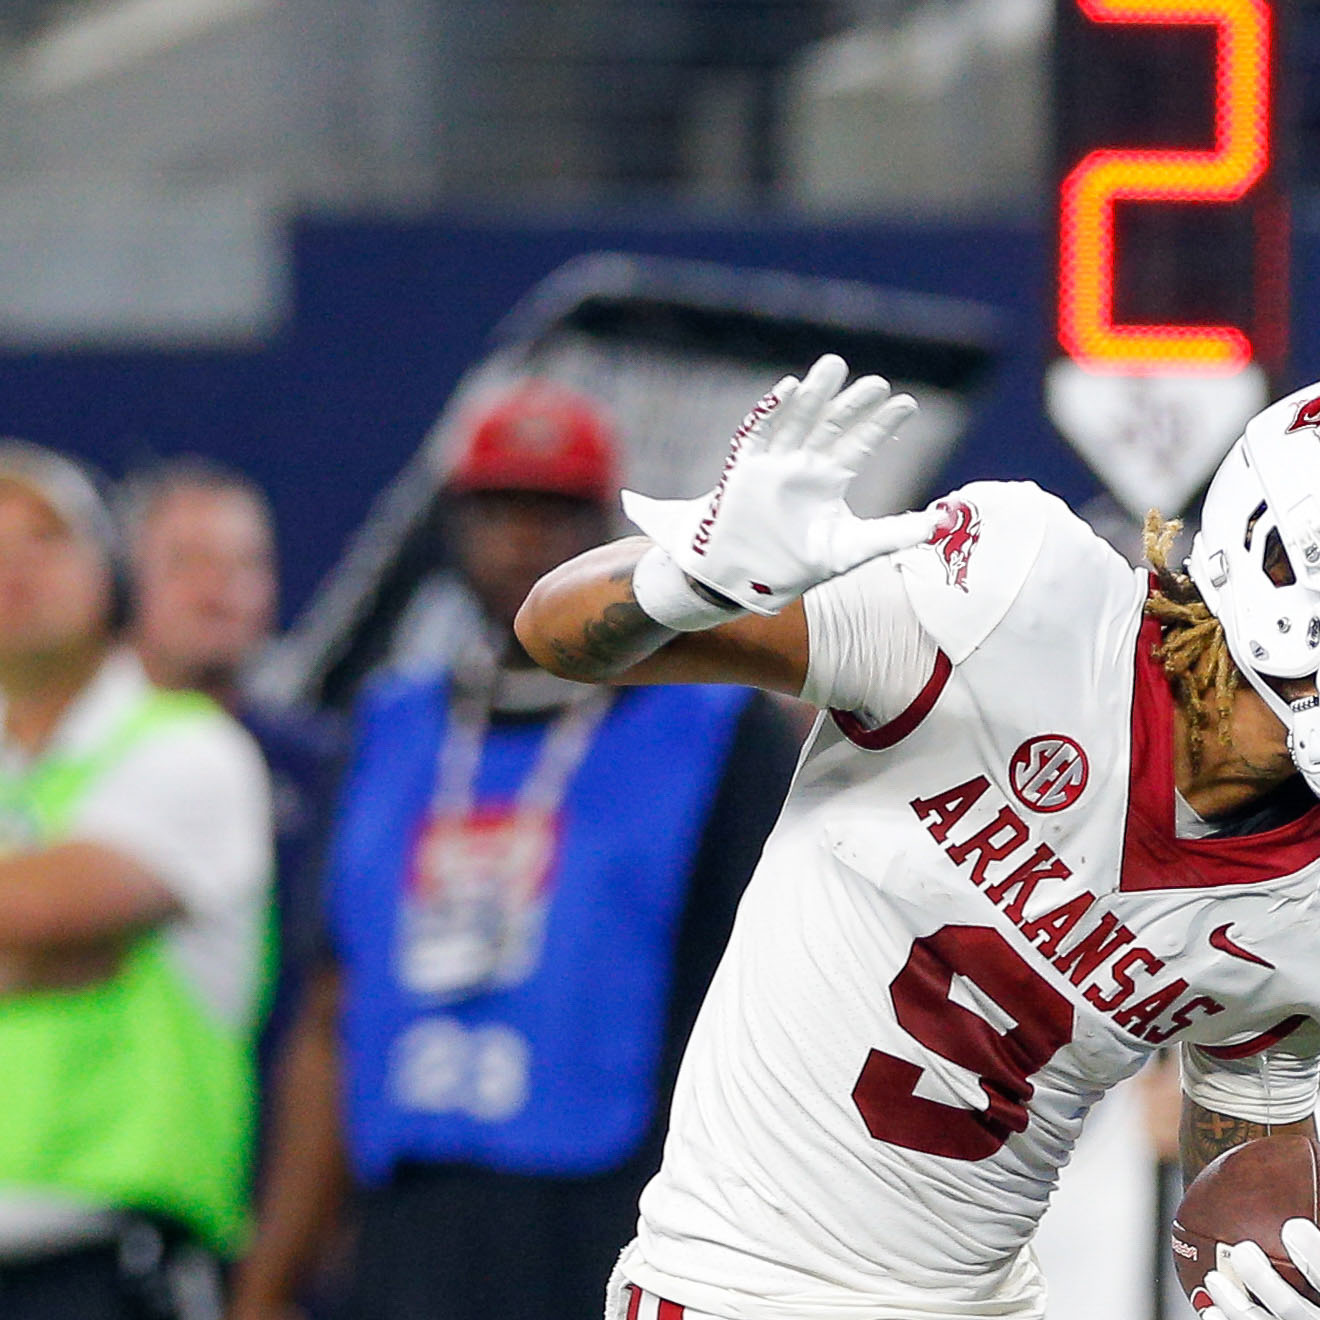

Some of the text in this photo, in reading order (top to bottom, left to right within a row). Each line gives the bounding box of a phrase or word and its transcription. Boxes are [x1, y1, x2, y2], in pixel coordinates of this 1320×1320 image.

[1057, 0, 1252, 377] 2
[1014, 739, 1083, 807] SEC
[910, 775, 1225, 1043] ARKANSAS
[851, 924, 1075, 1162] 9
